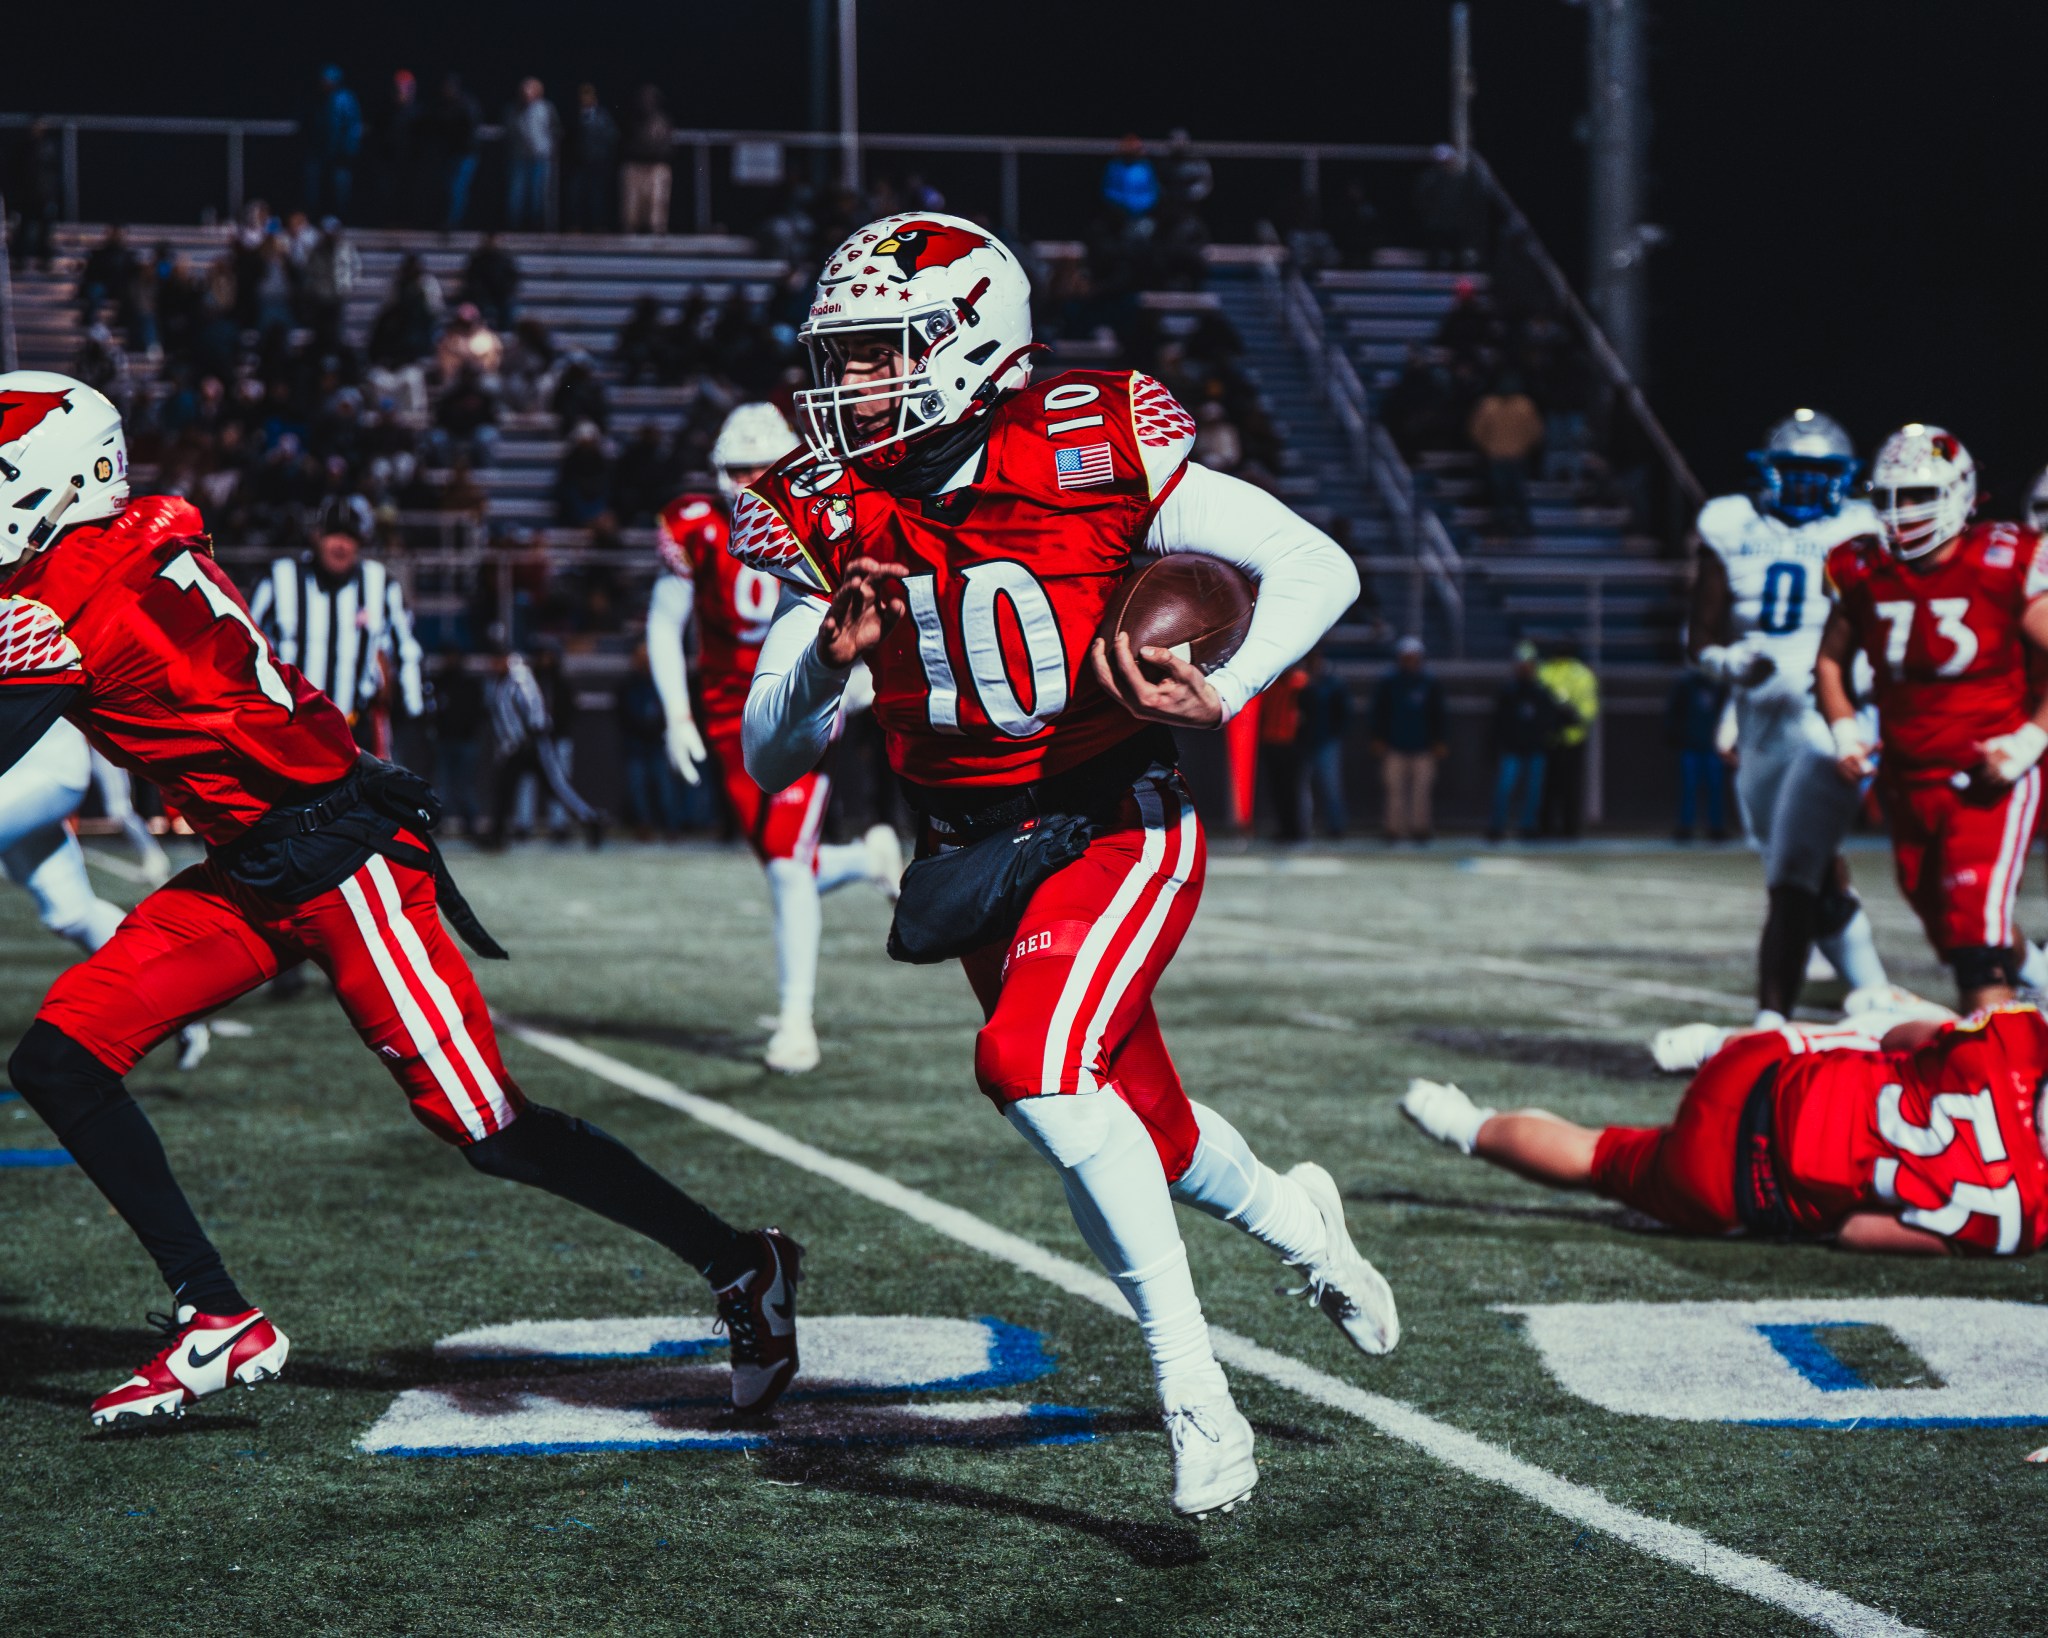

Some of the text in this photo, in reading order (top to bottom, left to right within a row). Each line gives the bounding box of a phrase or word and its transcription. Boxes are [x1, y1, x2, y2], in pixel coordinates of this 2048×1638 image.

[1044, 383, 1105, 438] 10
[1760, 561, 1806, 636] 0
[901, 560, 1069, 737] 10
[1874, 597, 1978, 680] 73
[1015, 930, 1052, 959] RED
[1873, 1083, 2022, 1254] 55
